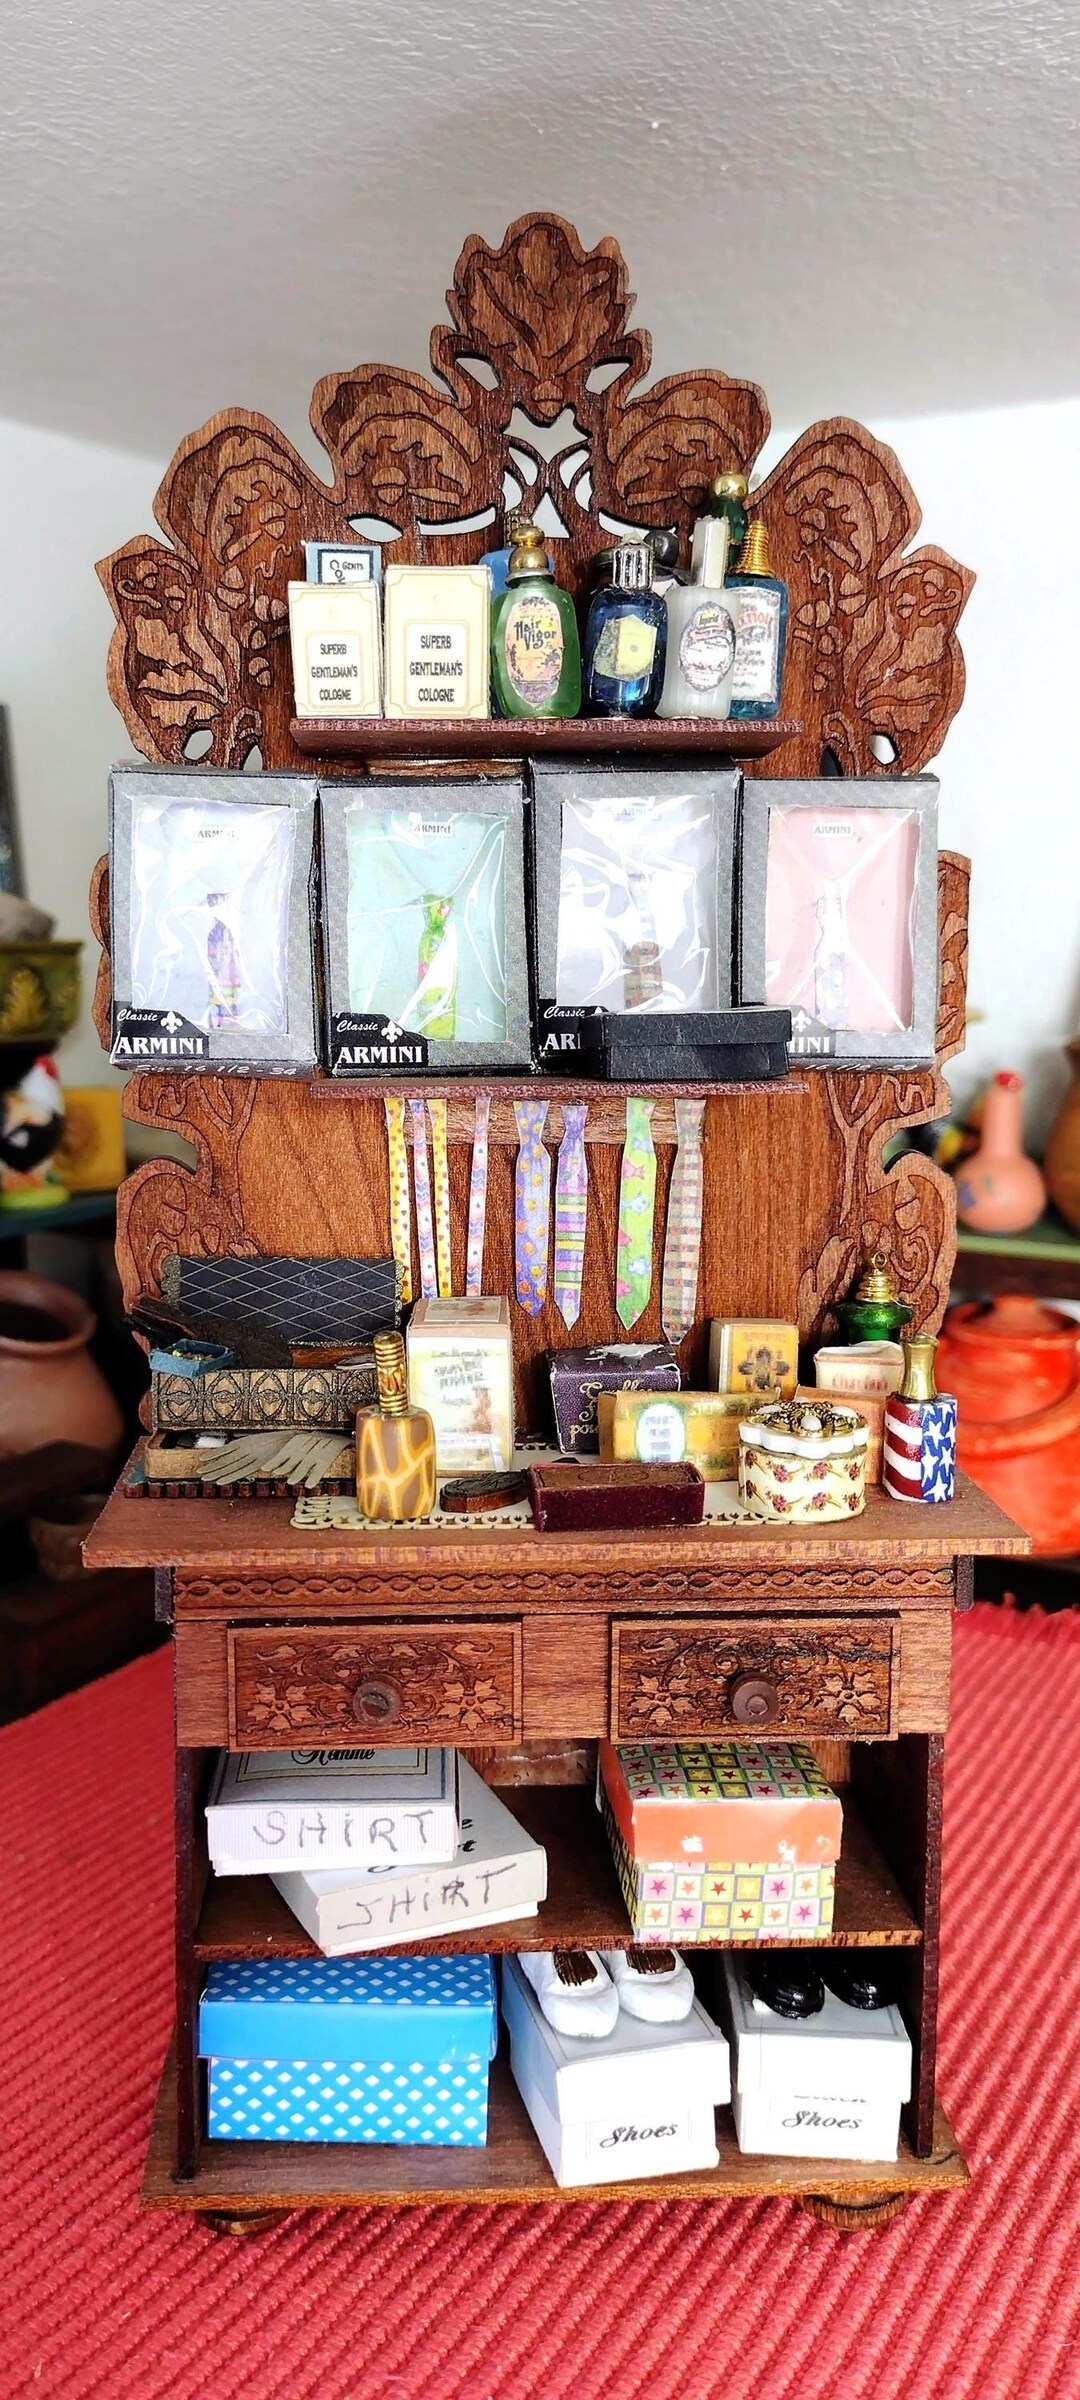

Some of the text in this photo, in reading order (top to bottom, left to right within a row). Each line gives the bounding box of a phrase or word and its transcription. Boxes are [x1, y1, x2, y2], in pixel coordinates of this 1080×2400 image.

[514, 618, 542, 641] Hair
[420, 635, 452, 649] SUPERB
[524, 630, 557, 650] Vigor
[320, 643, 347, 655] SUPERB
[311, 664, 358, 678] GENTLEMAN'S
[409, 660, 463, 677] GENTLEMAN'S
[319, 688, 352, 701] COLOGNE
[418, 687, 455, 702] COLOGNE
[117, 1008, 158, 1022] Classic
[543, 1006, 586, 1019] Classic
[337, 1019, 379, 1032] Classic
[116, 1037, 204, 1055] ARMINI
[338, 1046, 423, 1064] ARMINI
[781, 2109, 863, 2130] Shoes
[599, 2122, 679, 2149] Shoes
